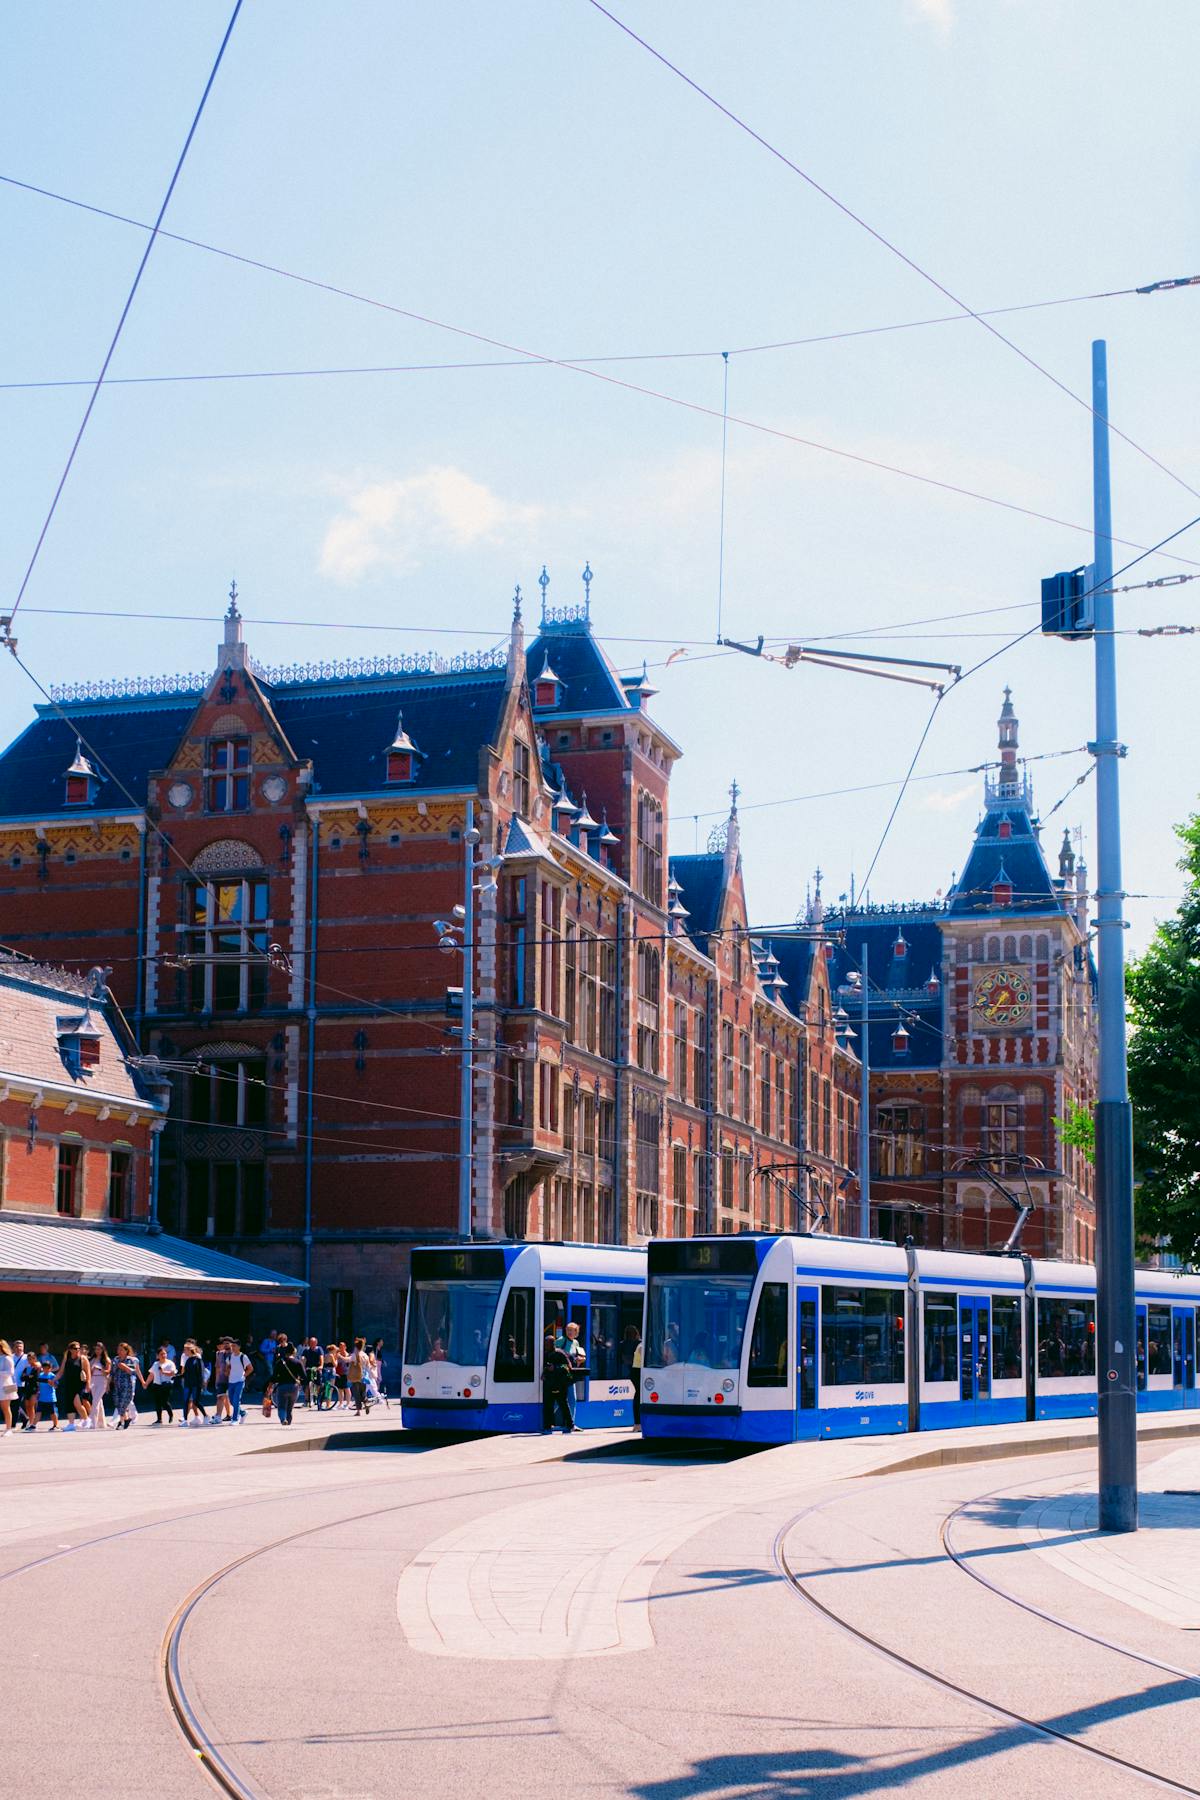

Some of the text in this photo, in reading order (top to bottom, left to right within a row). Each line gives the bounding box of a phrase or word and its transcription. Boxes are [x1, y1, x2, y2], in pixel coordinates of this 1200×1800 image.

[998, 973, 1008, 984] N
[454, 1254, 465, 1271] 12
[698, 1246, 710, 1265] 13
[618, 1385, 630, 1394] GVB
